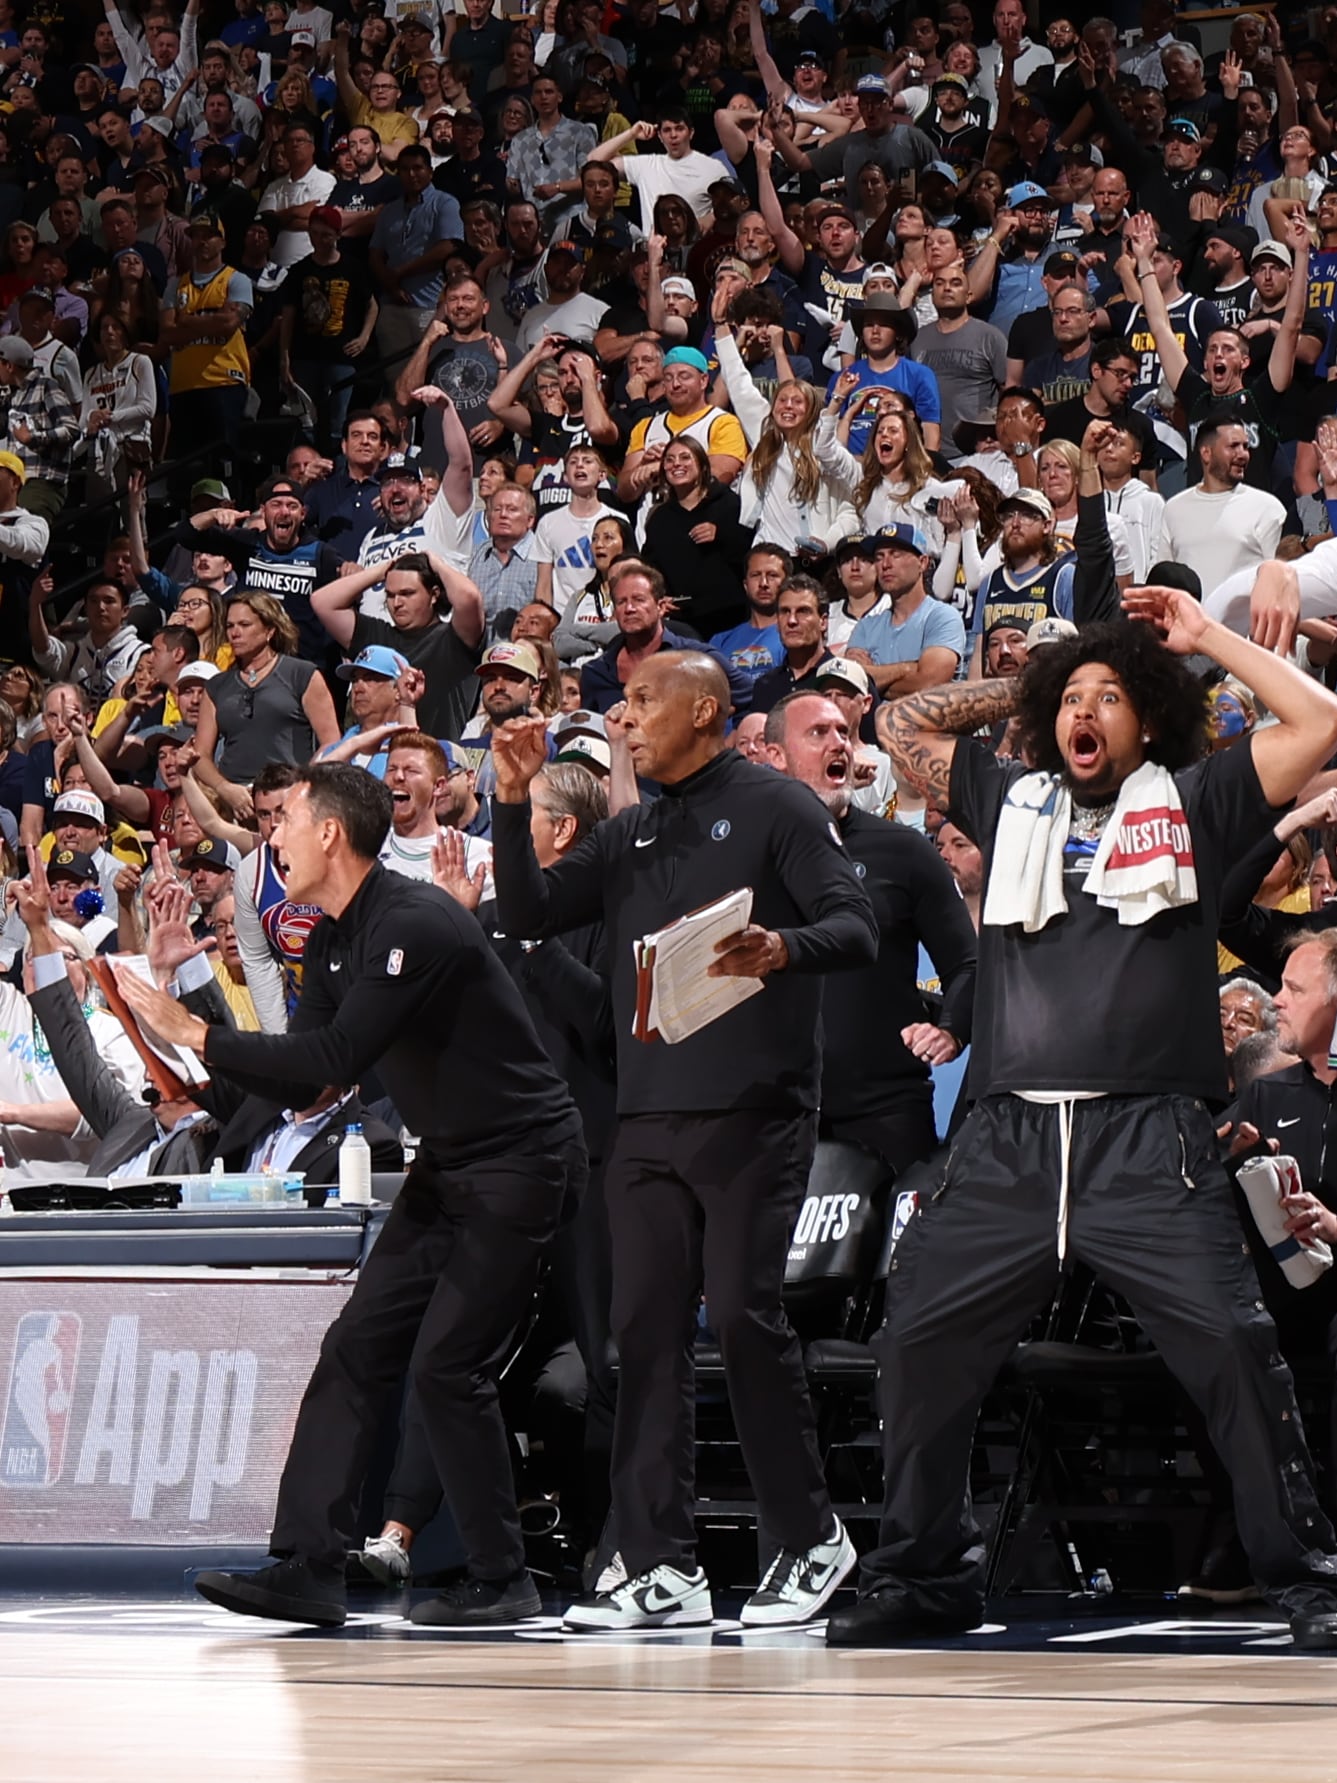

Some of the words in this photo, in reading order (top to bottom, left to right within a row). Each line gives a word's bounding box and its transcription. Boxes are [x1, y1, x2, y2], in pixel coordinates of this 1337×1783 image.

[1309, 281, 1335, 309] 27
[245, 569, 314, 596] MINNESOTA
[5, 1447, 40, 1478] NBA
[74, 1313, 259, 1521] App
